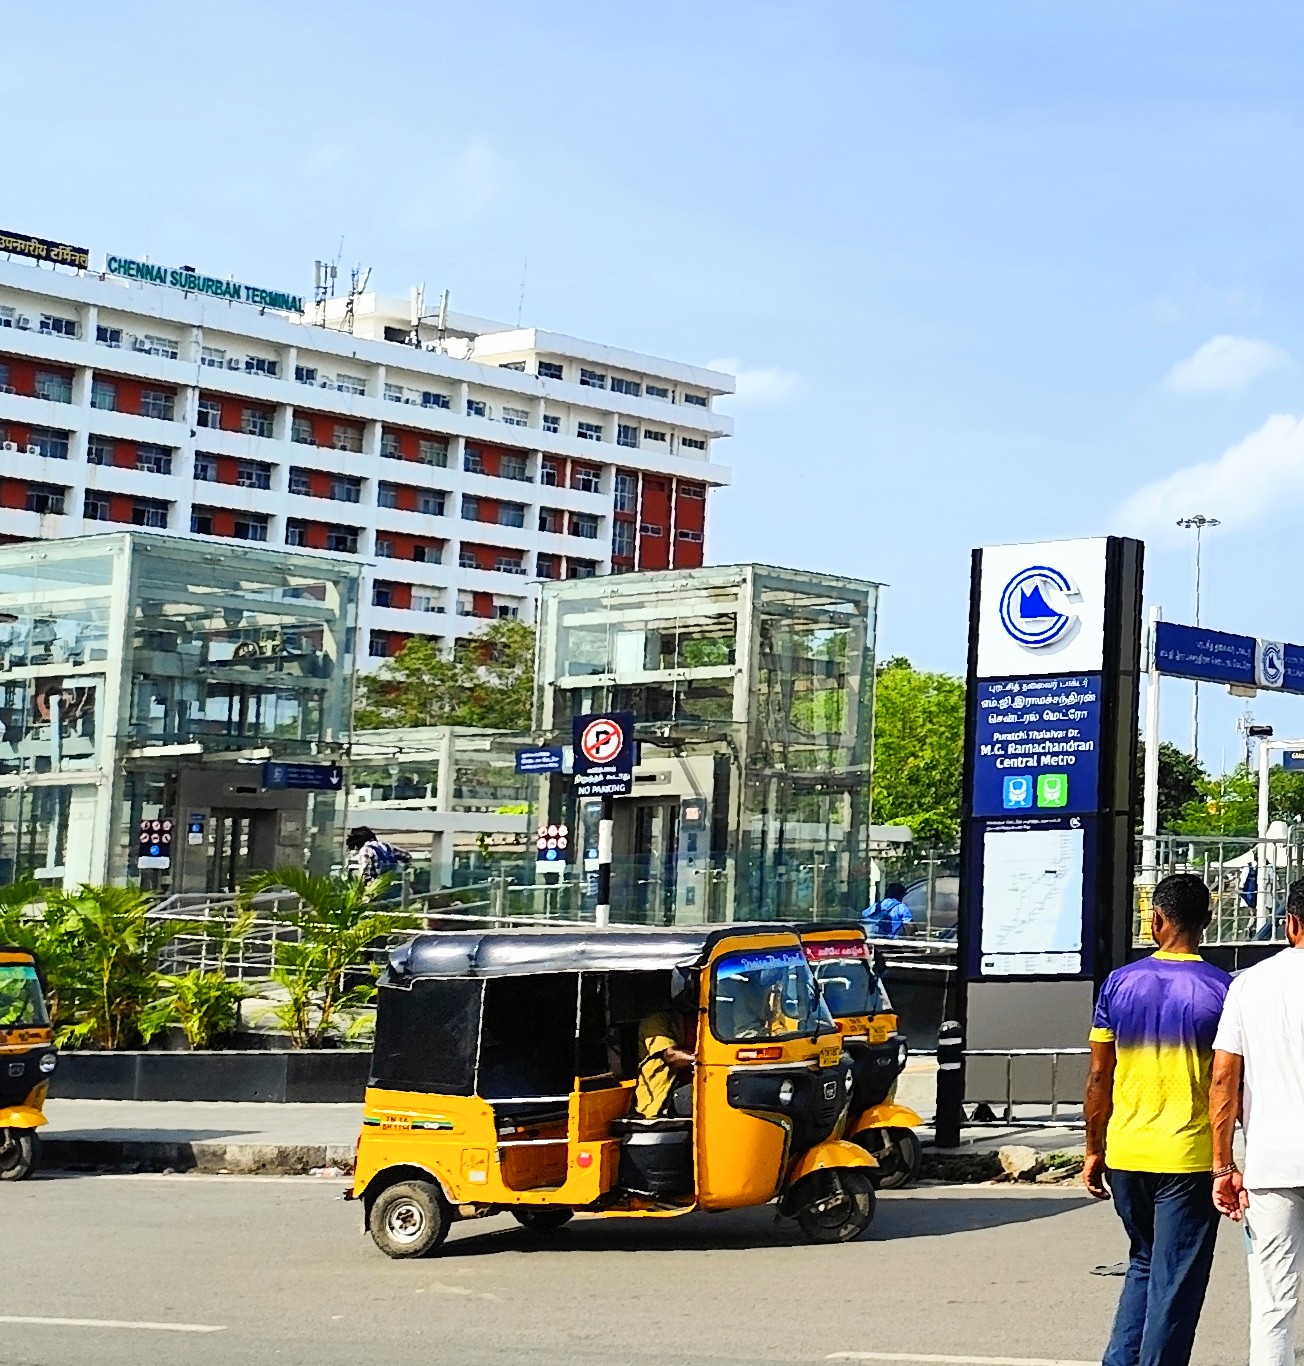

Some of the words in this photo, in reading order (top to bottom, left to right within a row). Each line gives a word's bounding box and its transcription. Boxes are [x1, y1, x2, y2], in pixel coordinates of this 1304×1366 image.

[107, 256, 168, 284] CHENNAI
[170, 271, 241, 299] SUBURBAN
[245, 286, 304, 312] TERMINAL
[1007, 740, 1094, 754] Ramachandran
[996, 755, 1037, 768] Central
[1040, 755, 1076, 766] Metro
[578, 786, 590, 795] NO
[592, 784, 625, 793] PARKING
